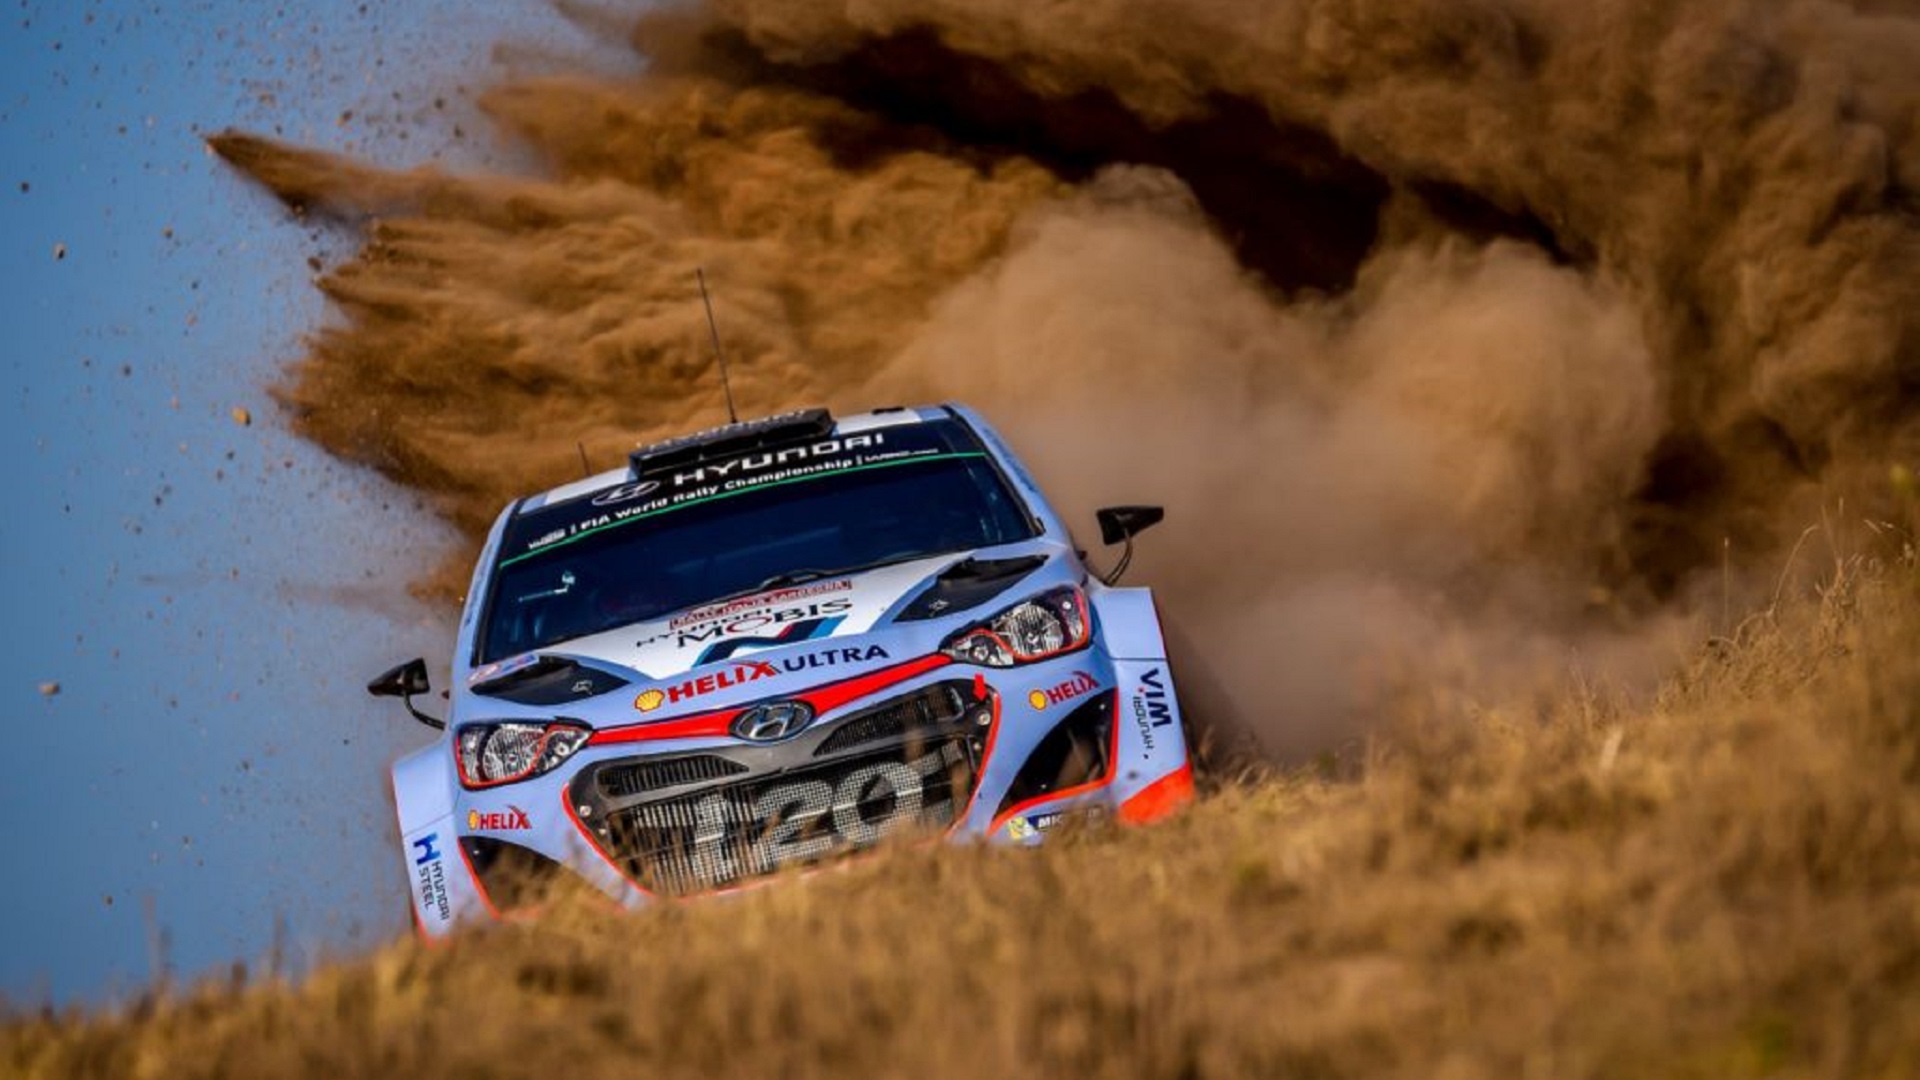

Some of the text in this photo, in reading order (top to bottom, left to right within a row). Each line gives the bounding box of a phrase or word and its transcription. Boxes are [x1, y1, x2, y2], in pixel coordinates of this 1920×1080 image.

[674, 432, 885, 485] HYUNDAI
[581, 514, 611, 531] FIA
[614, 498, 668, 519] World
[673, 484, 719, 504] Rally
[724, 459, 853, 491] Championship
[636, 608, 772, 648] HYUNDAI
[678, 597, 853, 648] MOBIS
[667, 644, 890, 703] HELIX ULTRA
[1046, 671, 1101, 704] HELIX
[1132, 696, 1155, 750] HYUNDAI
[479, 805, 532, 830] HELIX
[418, 867, 434, 911] STEEL
[430, 861, 450, 921] HYUNDAI
